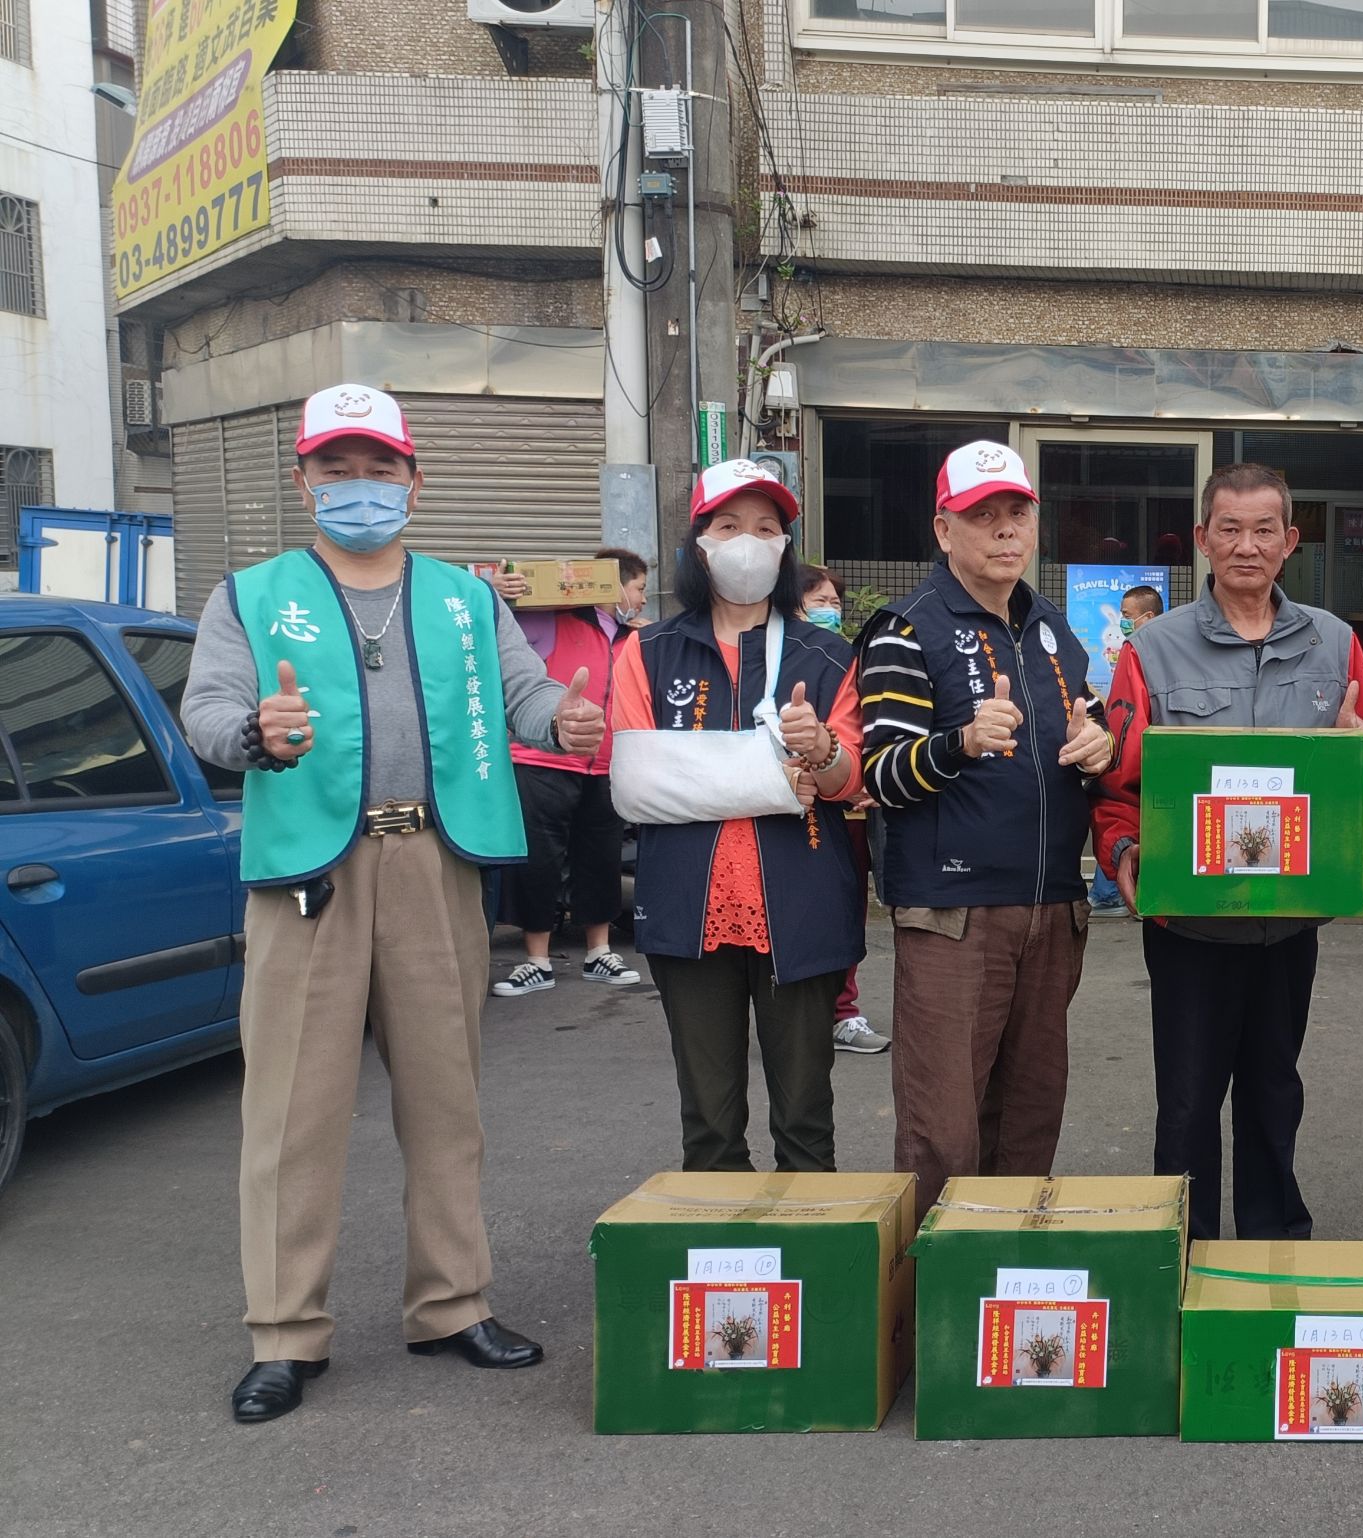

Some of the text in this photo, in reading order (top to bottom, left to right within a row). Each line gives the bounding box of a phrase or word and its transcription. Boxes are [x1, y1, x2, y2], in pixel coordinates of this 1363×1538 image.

[118, 108, 261, 240] 0937-118806
[119, 170, 263, 289] 03-4899777
[1073, 580, 1109, 593] TRAVEL
[270, 601, 321, 643] 志
[444, 597, 492, 780] 隆祥經濟發展基金會
[1216, 779, 1259, 789] 1月13日
[695, 1259, 744, 1274] 1月13日
[1004, 1281, 1055, 1294] 1月13日
[682, 1292, 690, 1358] 隆祥經濟發展基金會
[991, 1310, 1000, 1376] 隆祥經濟發展基金會
[1302, 1329, 1353, 1342] 1月13日
[1288, 1360, 1296, 1424] 隆祥經濟發展基金會
